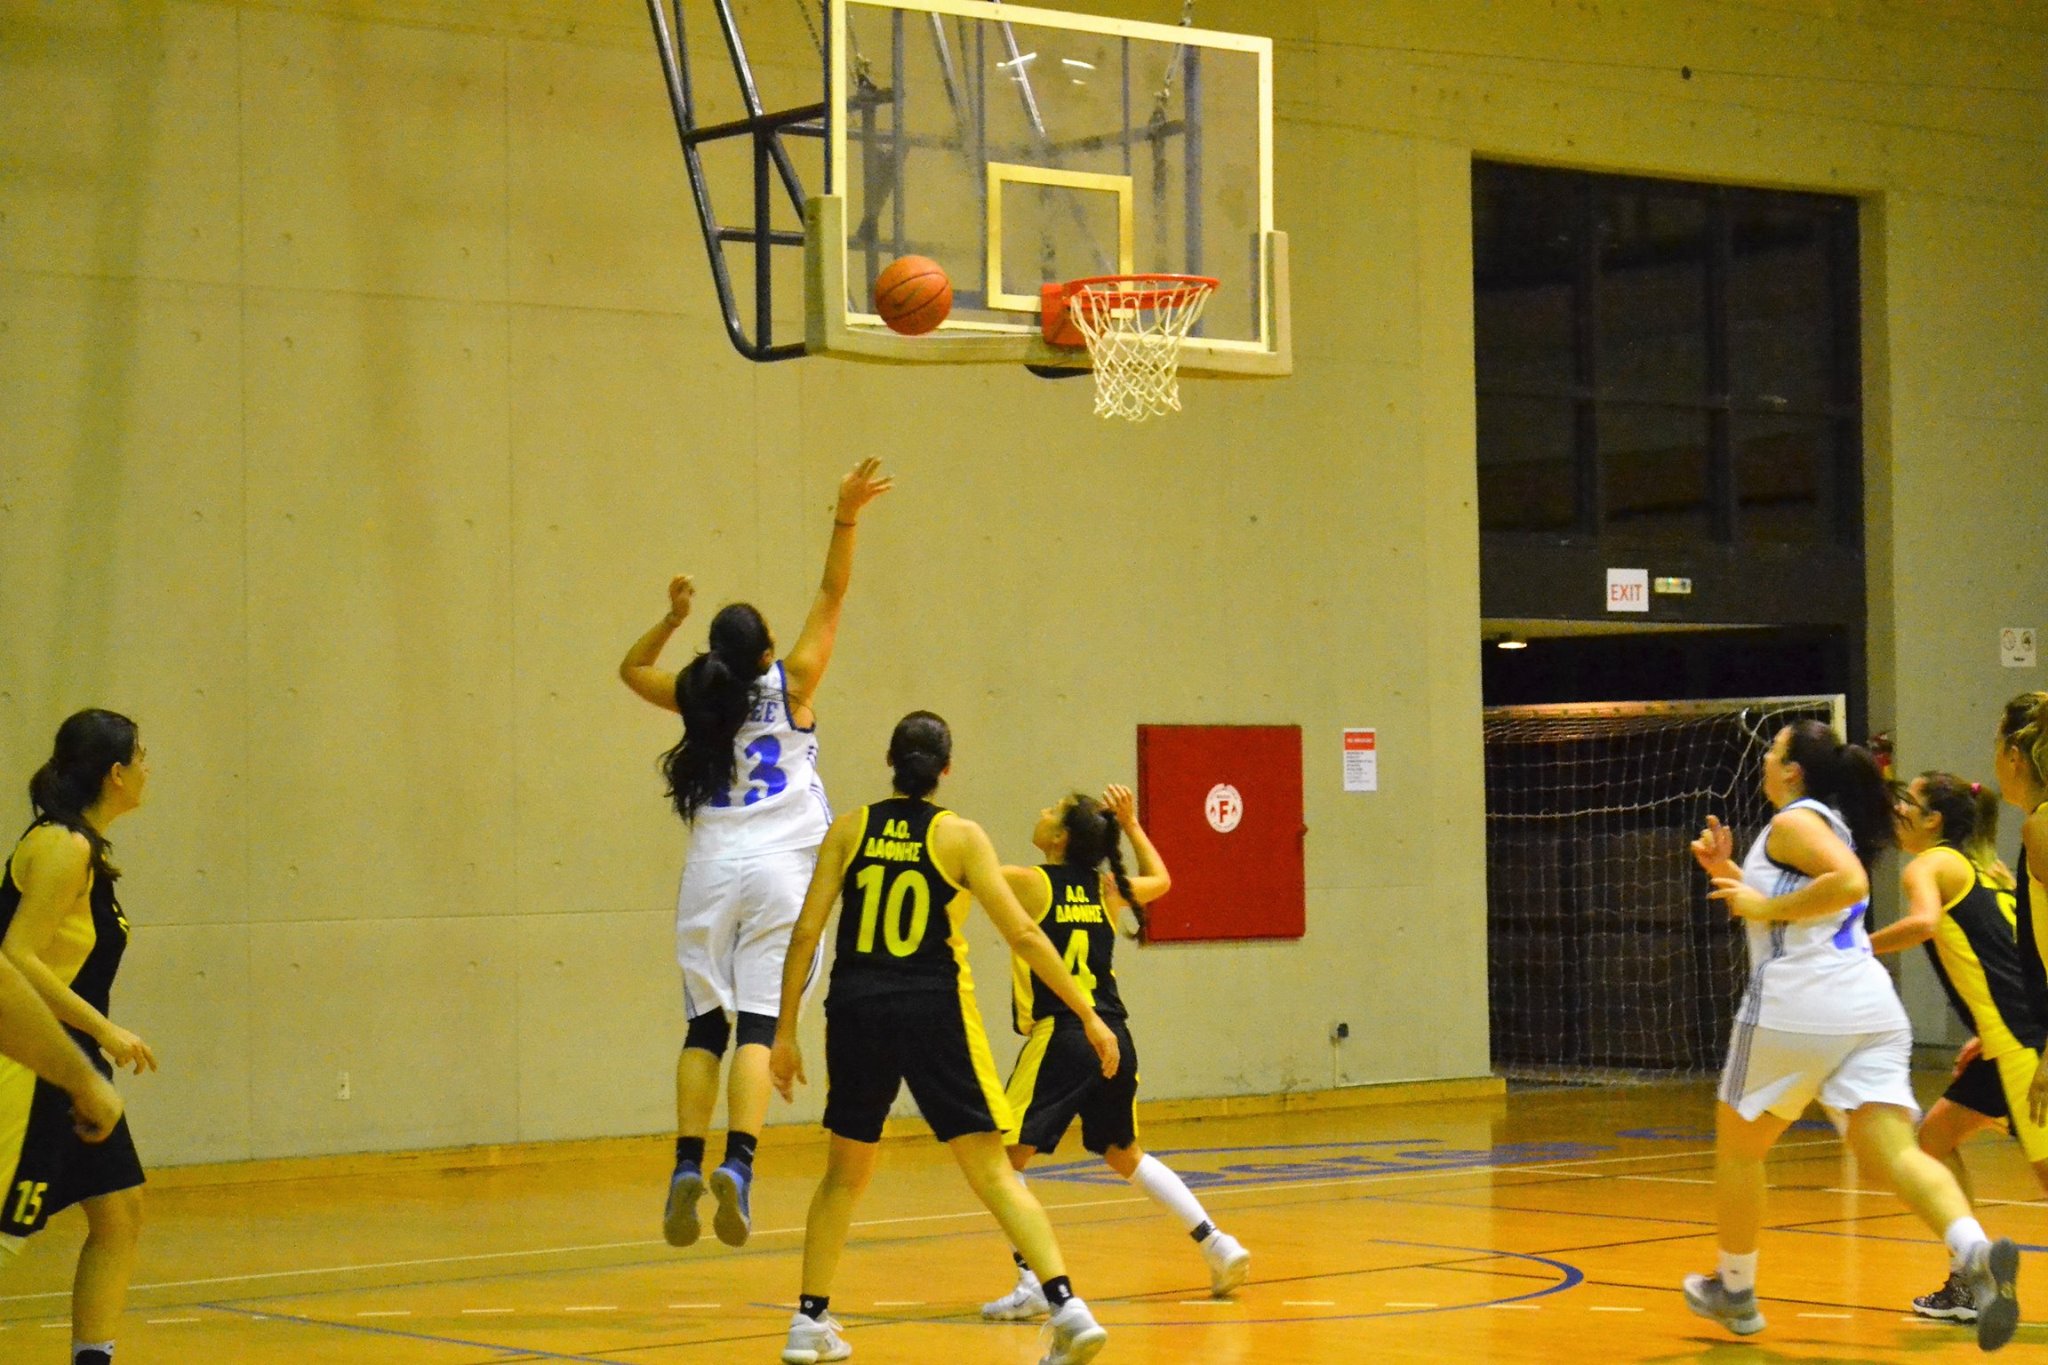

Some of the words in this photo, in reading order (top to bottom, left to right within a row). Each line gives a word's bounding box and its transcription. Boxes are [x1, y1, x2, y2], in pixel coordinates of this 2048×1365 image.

[1611, 584, 1642, 601] EXIT
[1219, 800, 1229, 824] F
[856, 864, 930, 957] 10
[1063, 929, 1097, 1007] 4
[13, 1180, 49, 1226] 15
